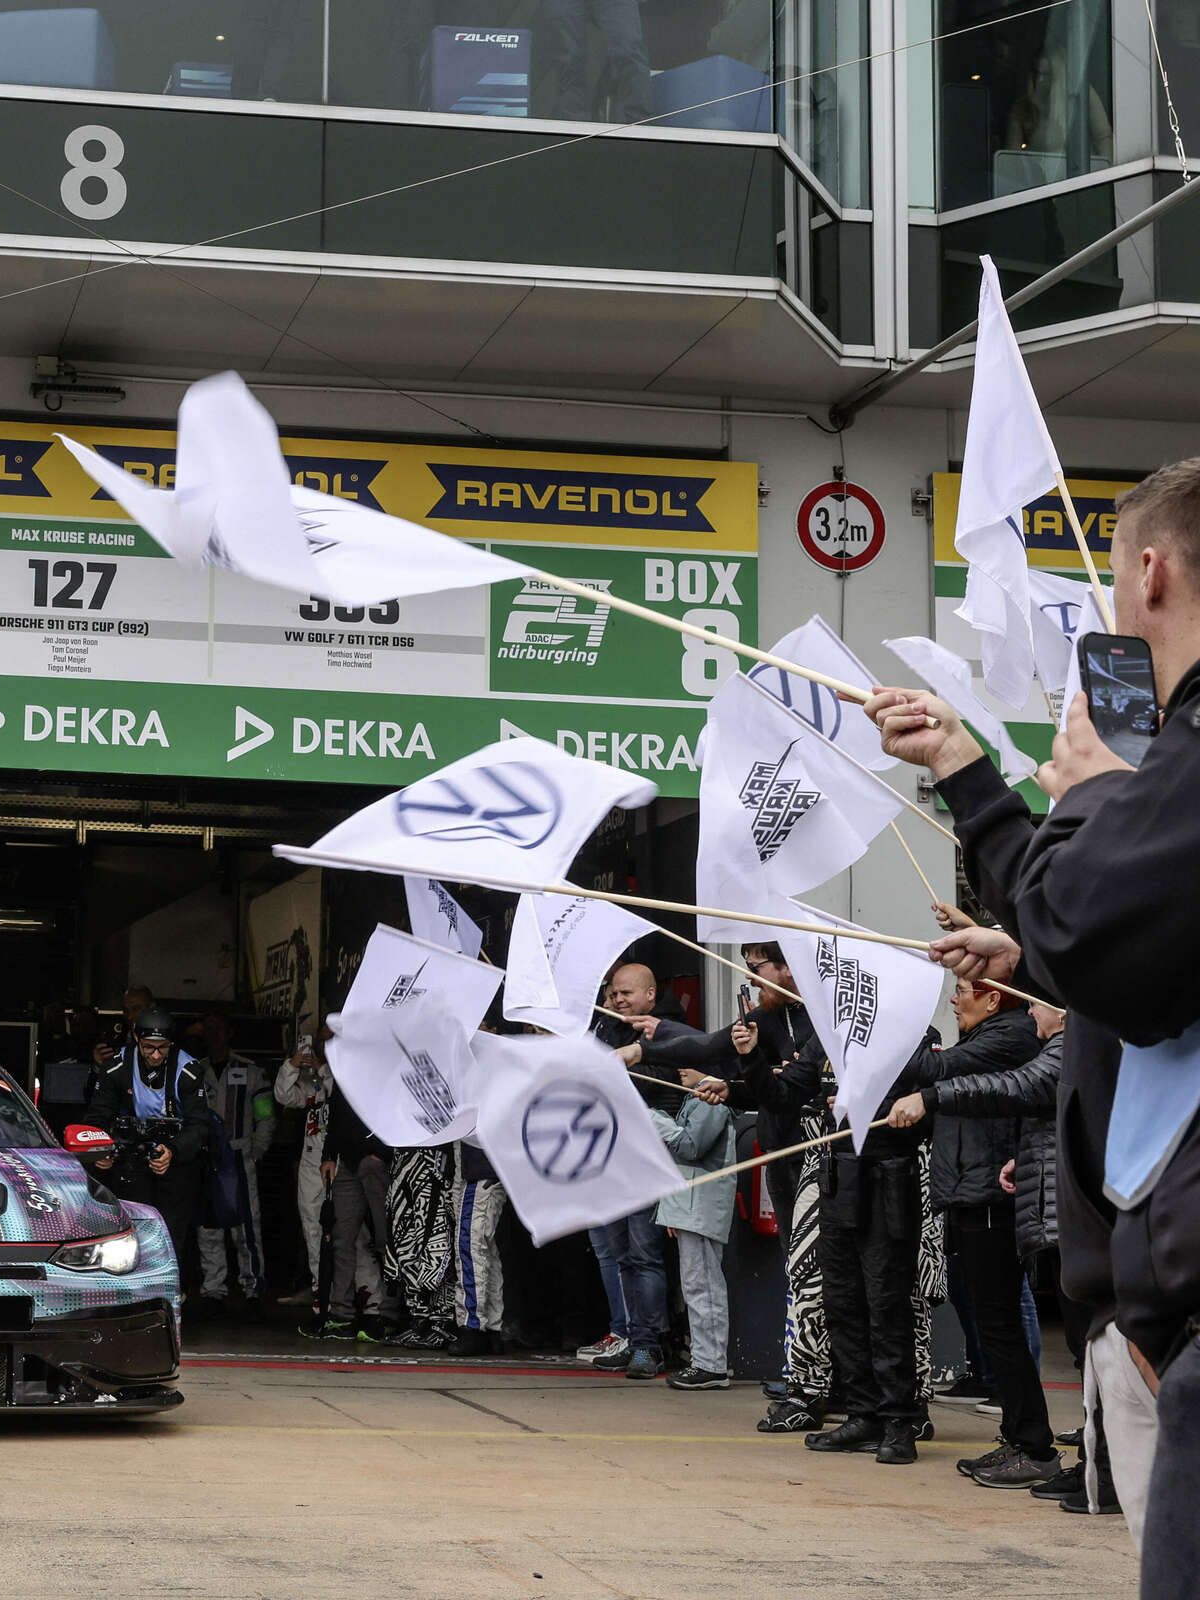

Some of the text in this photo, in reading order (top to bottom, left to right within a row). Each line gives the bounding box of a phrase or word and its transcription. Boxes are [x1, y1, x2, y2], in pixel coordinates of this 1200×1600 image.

[454, 32, 519, 43] FALKEN
[60, 124, 127, 221] 8
[455, 480, 687, 518] RAVENOL
[11, 527, 135, 548] MAX KRUSE RACING
[815, 506, 868, 543] 3,2m
[28, 558, 117, 610] 127
[644, 557, 743, 606] BOX
[47, 619, 64, 630] 911
[67, 620, 89, 632] GT3
[91, 621, 115, 633] CUP
[117, 620, 150, 637] (992)
[284, 630, 415, 648] VW GOLF 7 GTI TCR DSG
[525, 633, 550, 643] ADAC
[497, 643, 598, 666] nürburgring
[681, 608, 740, 697] 8
[23, 704, 170, 748] DEKRA
[292, 717, 436, 760] DEKRA
[26, 1192, 54, 1214] 50
